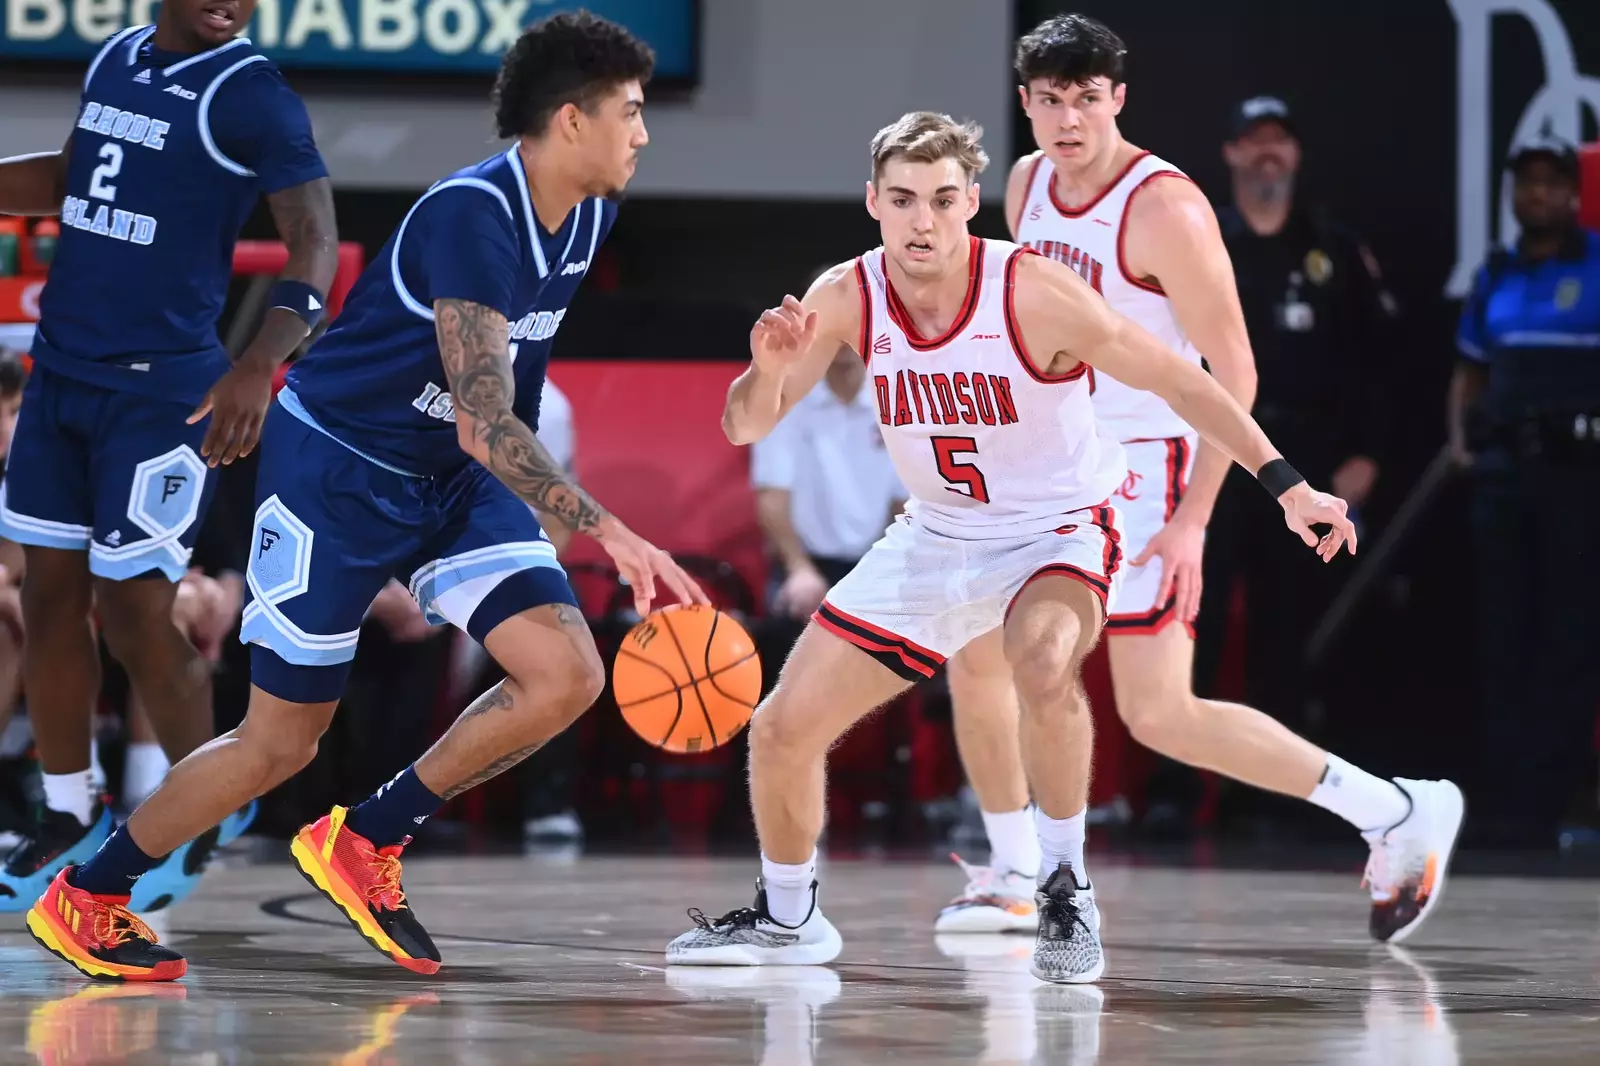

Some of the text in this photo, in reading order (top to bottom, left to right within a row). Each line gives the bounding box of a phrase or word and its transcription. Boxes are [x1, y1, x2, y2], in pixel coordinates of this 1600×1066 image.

[77, 101, 171, 151] RHODE
[88, 141, 124, 202] 2
[873, 368, 1019, 427] DAVIDSON
[929, 435, 990, 504] 5
